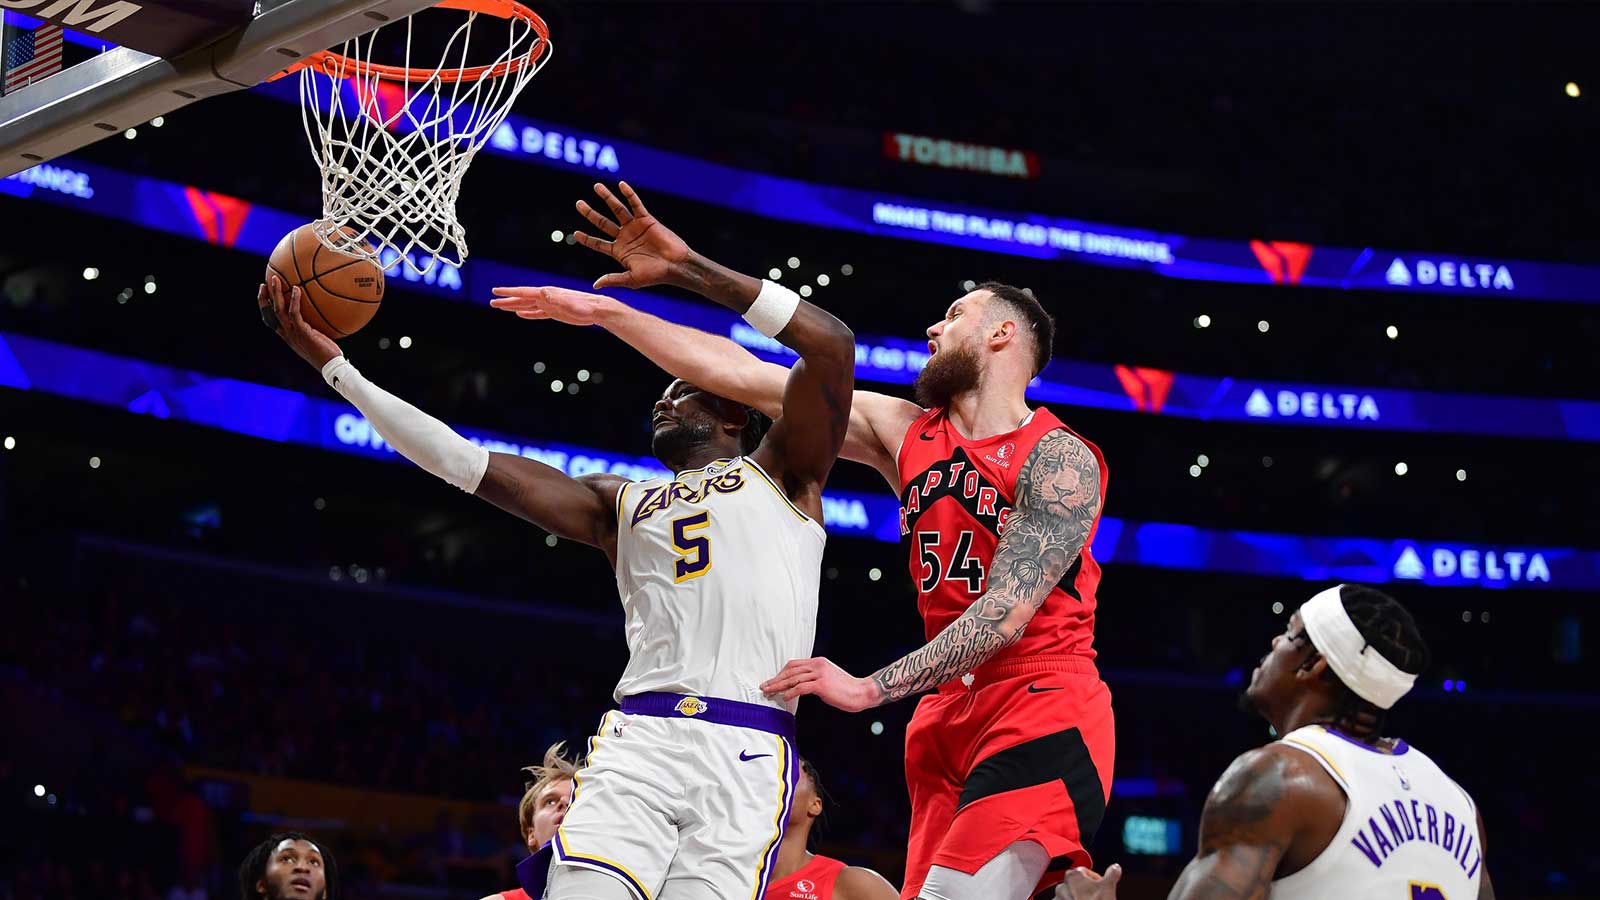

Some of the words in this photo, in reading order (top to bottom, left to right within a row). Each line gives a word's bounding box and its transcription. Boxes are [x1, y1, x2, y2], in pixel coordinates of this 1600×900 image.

[521, 126, 620, 173] DELTA
[894, 133, 1029, 178] TOSHIBA
[376, 247, 462, 291] ELTA
[1416, 260, 1515, 290] DELTA
[1277, 390, 1380, 422] DELTA
[899, 462, 1012, 536] RAPTORS
[671, 510, 712, 585] 5
[917, 530, 985, 594] 54
[1432, 548, 1552, 582] DELTA
